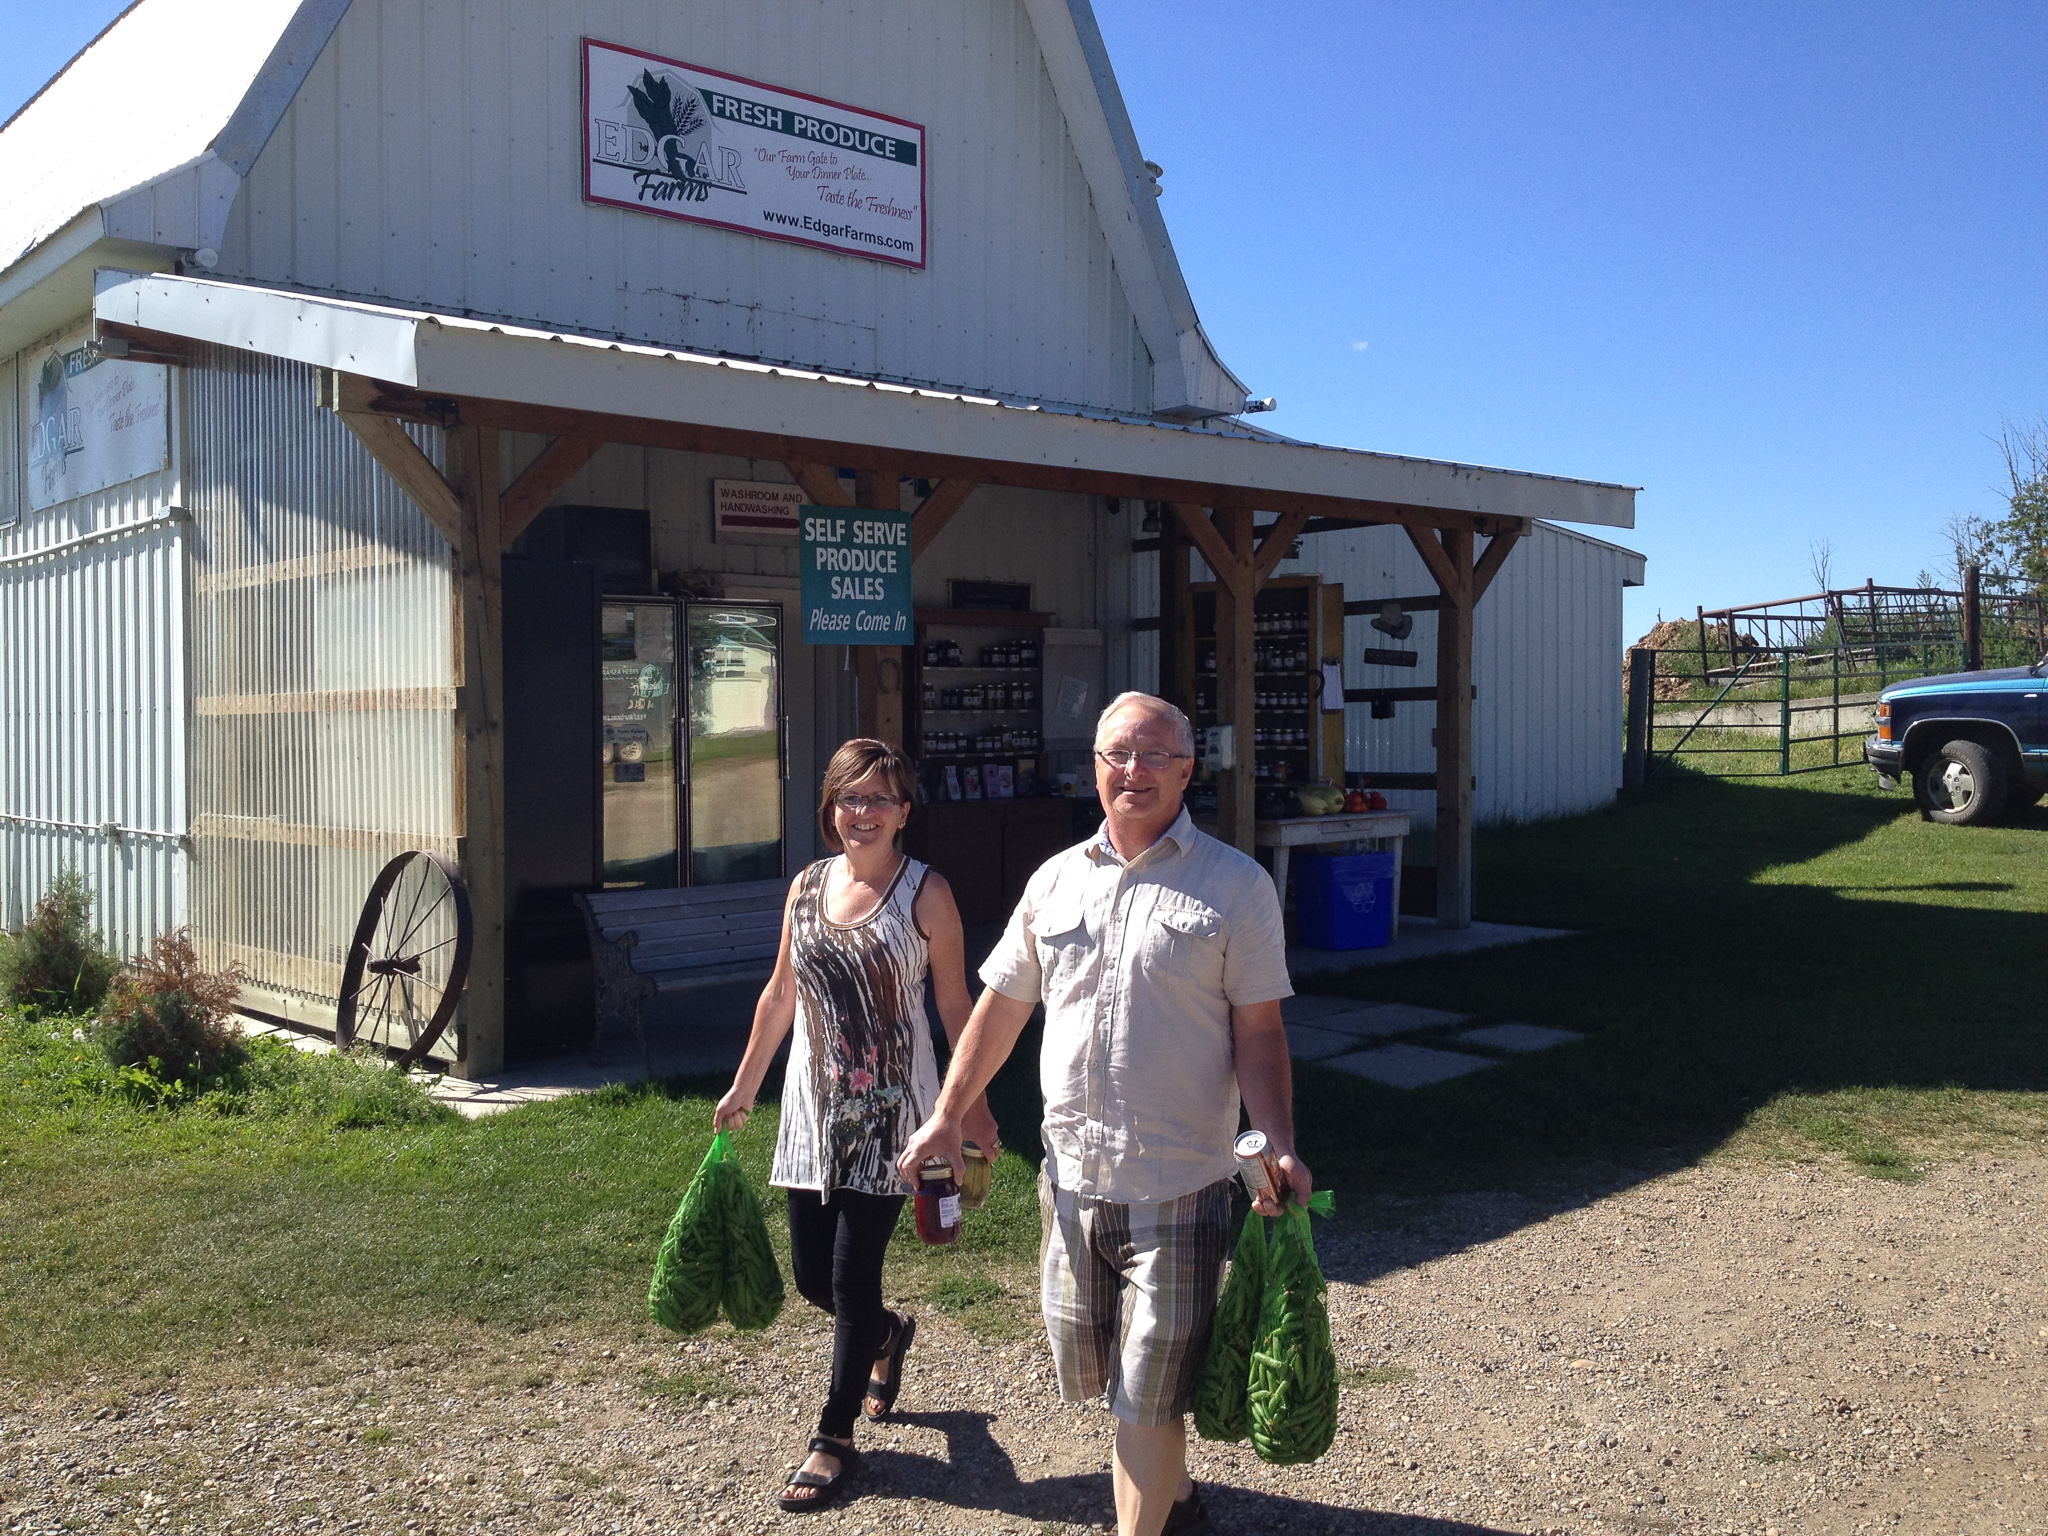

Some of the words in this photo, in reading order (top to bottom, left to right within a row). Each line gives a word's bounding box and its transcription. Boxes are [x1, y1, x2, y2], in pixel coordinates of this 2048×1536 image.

[712, 94, 782, 129] FRESH
[794, 116, 896, 158] PRODUCE
[594, 118, 746, 189] EDGAR
[778, 149, 805, 164] Farm
[807, 150, 828, 166] Gate
[829, 152, 838, 165] to
[632, 168, 712, 201] Farms
[786, 165, 810, 181] Your
[812, 165, 842, 180] Dinner
[817, 185, 845, 205] Taste
[847, 188, 863, 209] the
[762, 210, 914, 252] www.EdgarFarms.com
[720, 488, 779, 502] WASHROOM
[782, 493, 803, 503] AND
[720, 502, 790, 515] HANDWASHING
[804, 517, 846, 542] SELF
[853, 520, 907, 546] SERVE
[816, 547, 897, 573] PRODUCE
[830, 576, 885, 601] SALES
[809, 607, 851, 631] Please
[855, 609, 889, 632] Come
[894, 610, 907, 632] In
